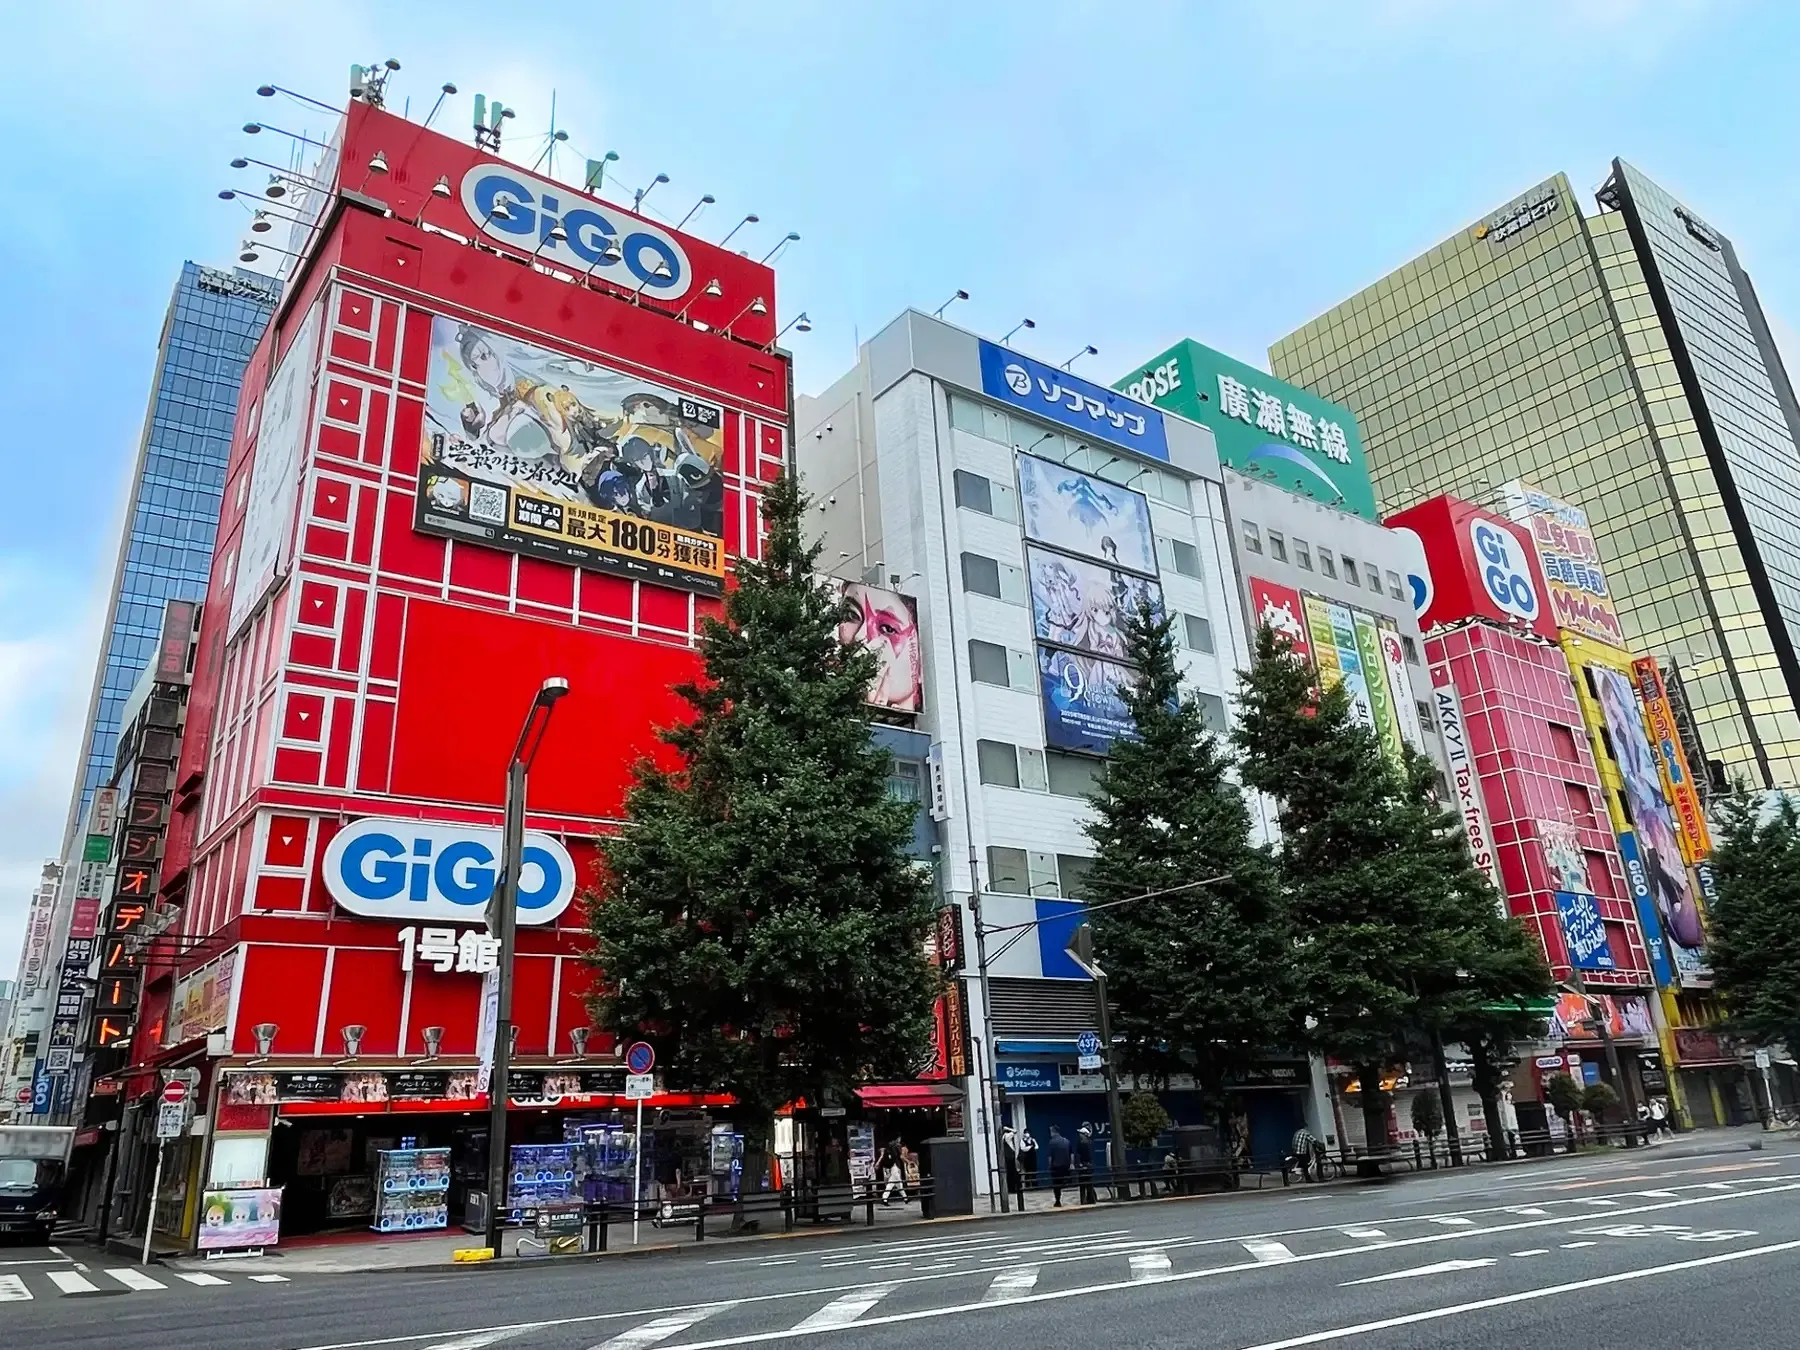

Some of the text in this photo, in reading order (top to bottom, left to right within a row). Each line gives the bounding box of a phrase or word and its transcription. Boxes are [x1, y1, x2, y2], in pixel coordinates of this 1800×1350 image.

[475, 175, 681, 288] GiGO
[1038, 376, 1146, 436] ソフマップ
[1216, 373, 1352, 464] 廣瀬無線
[518, 498, 561, 517] Ver.2.0
[566, 518, 607, 545] 最大
[607, 518, 655, 555] 180
[657, 530, 671, 543] 回
[657, 544, 671, 558] 分
[1063, 662, 1084, 702] 9
[1436, 692, 1462, 752] AKKY
[1455, 763, 1484, 849] Tax-free
[340, 832, 563, 910] GiGO
[1628, 859, 1648, 897] GiGO
[1559, 894, 1589, 927] ゲームの
[67, 950, 89, 960] ST
[69, 940, 91, 950] HB
[397, 926, 502, 973] 1号館
[64, 967, 86, 979] カード
[1080, 1038, 1096, 1049] 437
